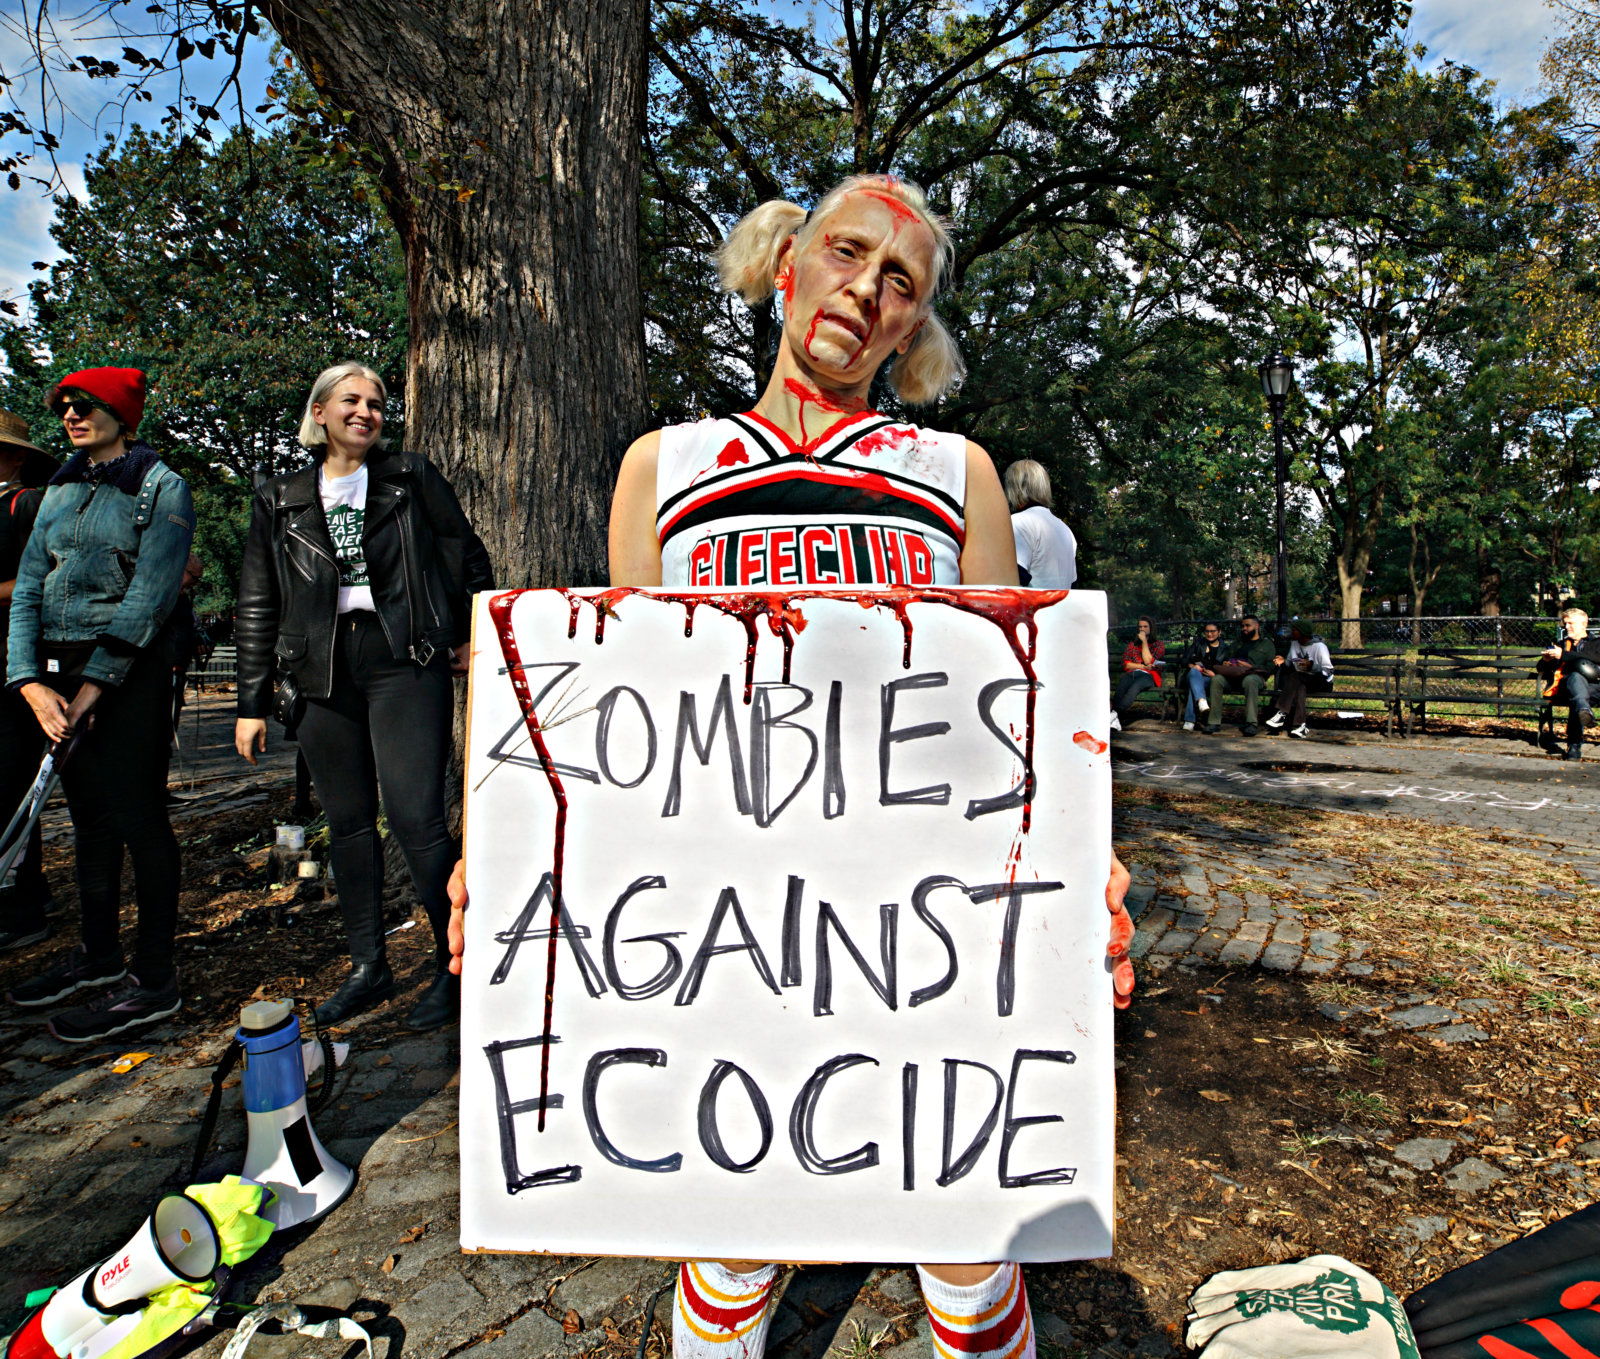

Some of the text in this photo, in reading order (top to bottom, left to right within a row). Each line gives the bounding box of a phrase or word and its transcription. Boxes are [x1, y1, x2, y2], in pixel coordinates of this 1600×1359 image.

[487, 661, 1044, 827] ZOMBIES
[490, 872, 1065, 1017] AGAINST
[483, 1035, 1077, 1194] ECOCIDE
[102, 1255, 130, 1286] PYLE
